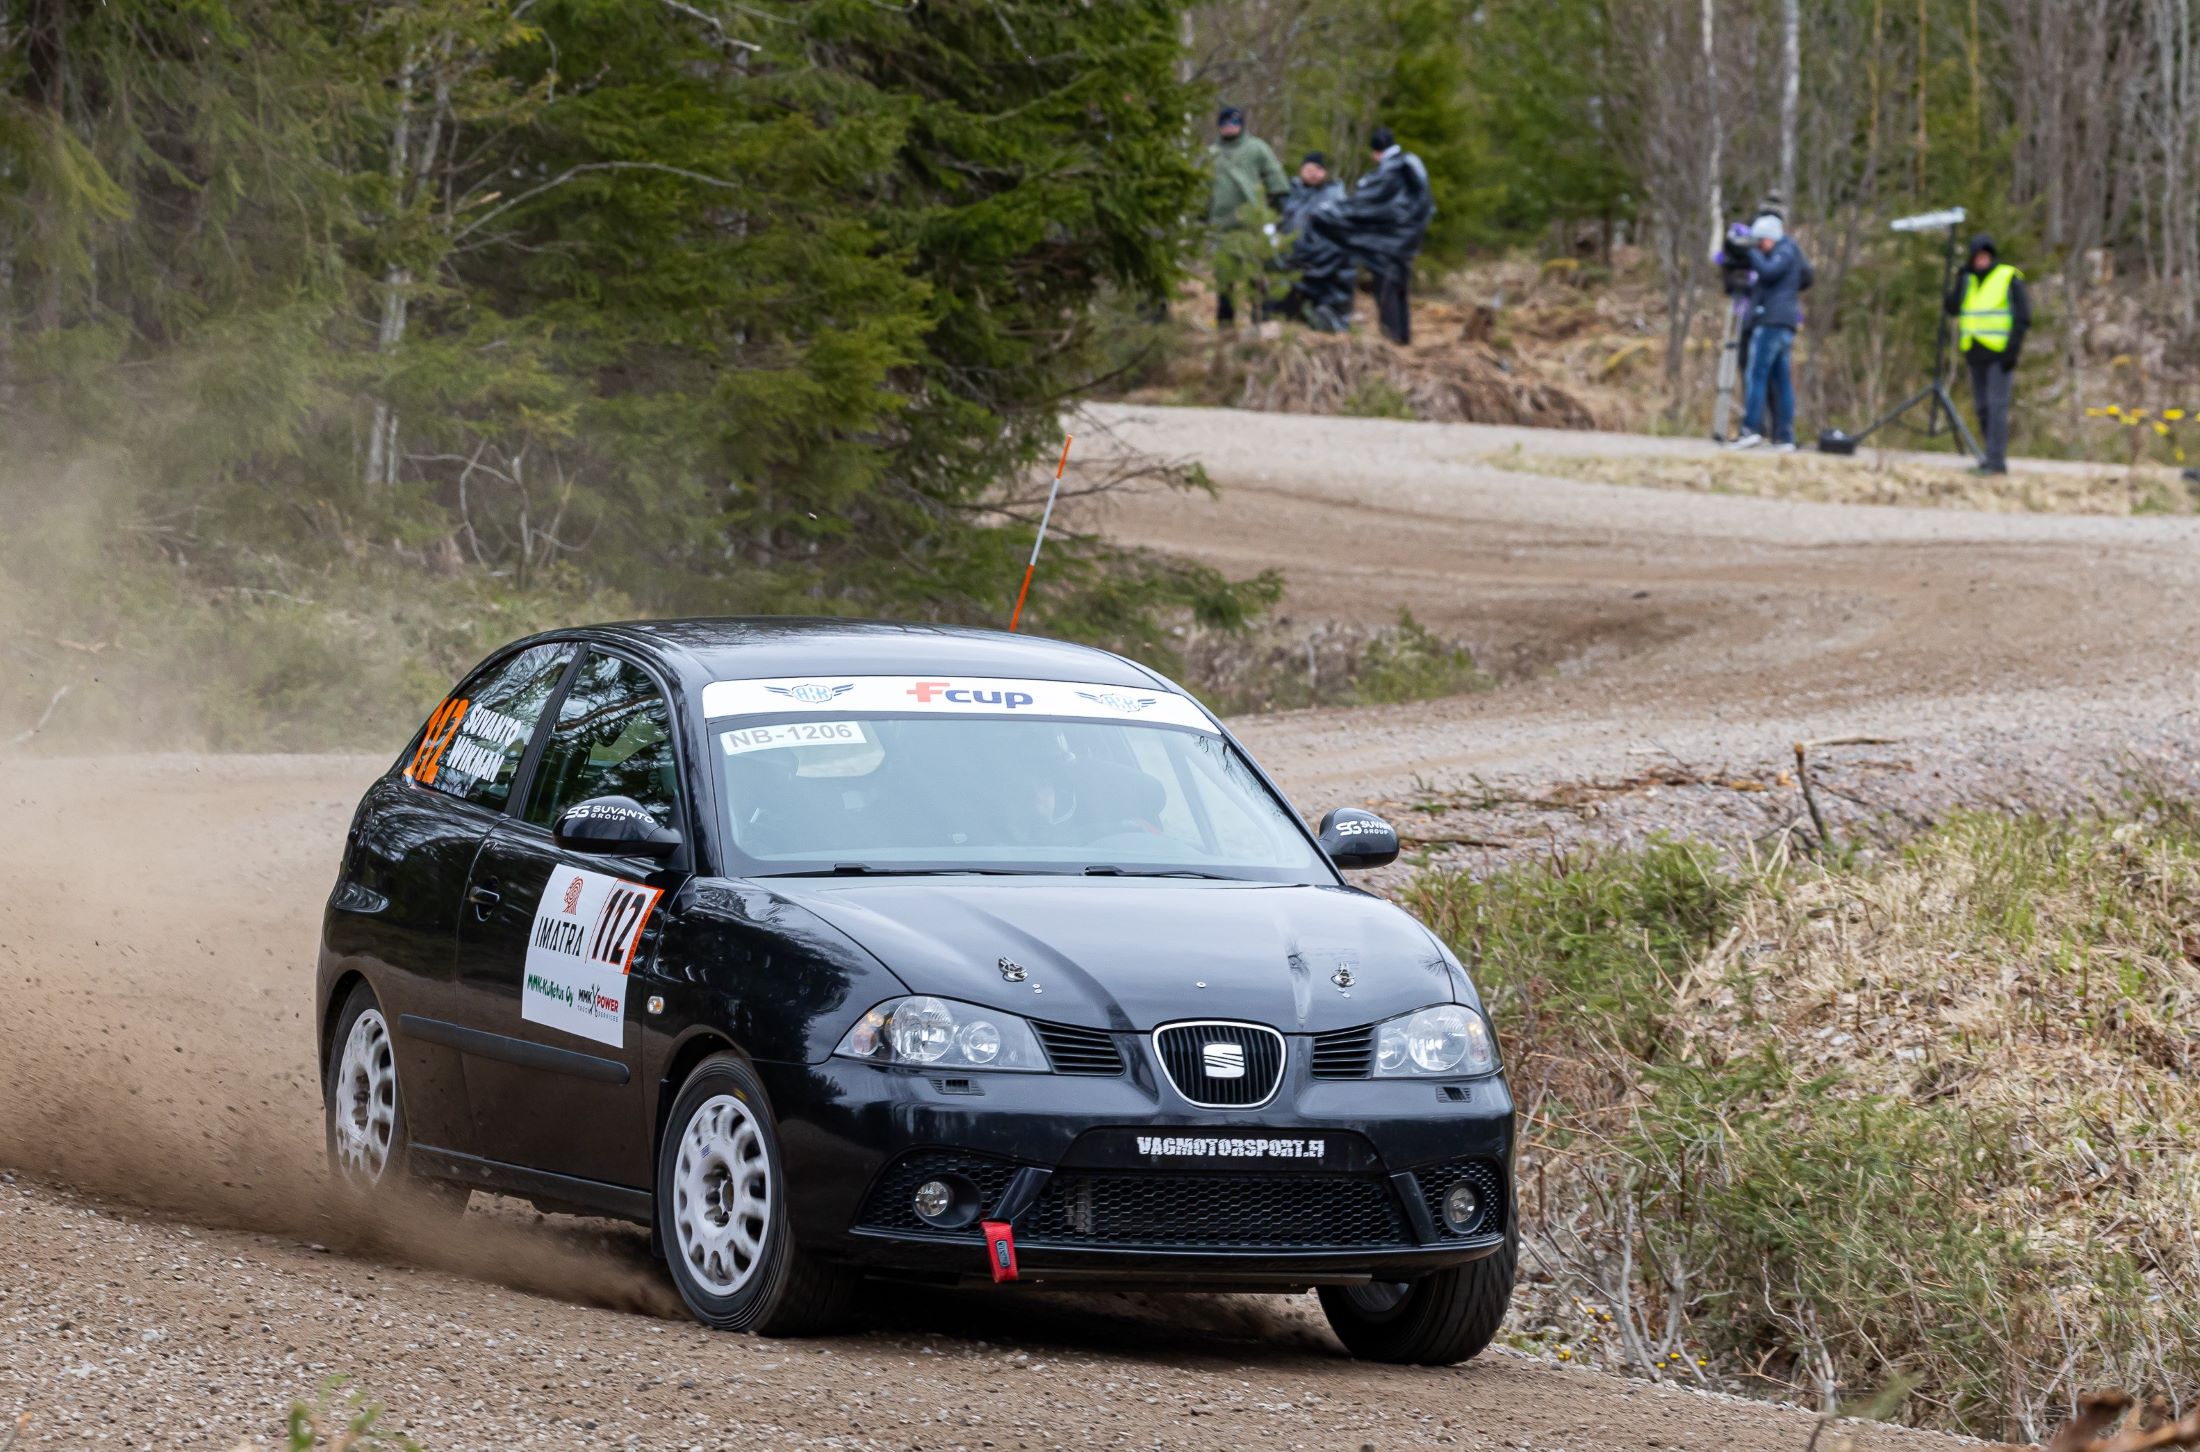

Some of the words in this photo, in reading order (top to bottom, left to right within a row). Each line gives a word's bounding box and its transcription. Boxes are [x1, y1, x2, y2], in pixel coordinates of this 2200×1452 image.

[404, 696, 470, 784] 112
[463, 703, 522, 747] SUVANTO
[729, 724, 853, 748] NB-1206
[446, 735, 505, 783] WIKMAN
[590, 813, 626, 821] GROUP
[592, 805, 655, 823] SUVANTO
[534, 916, 585, 957] IMATRA
[592, 888, 647, 965] 112
[578, 988, 593, 1004] MMK
[597, 994, 619, 1013] POWER
[1137, 1136, 1325, 1158] VAGMOTORSPORT.FI
